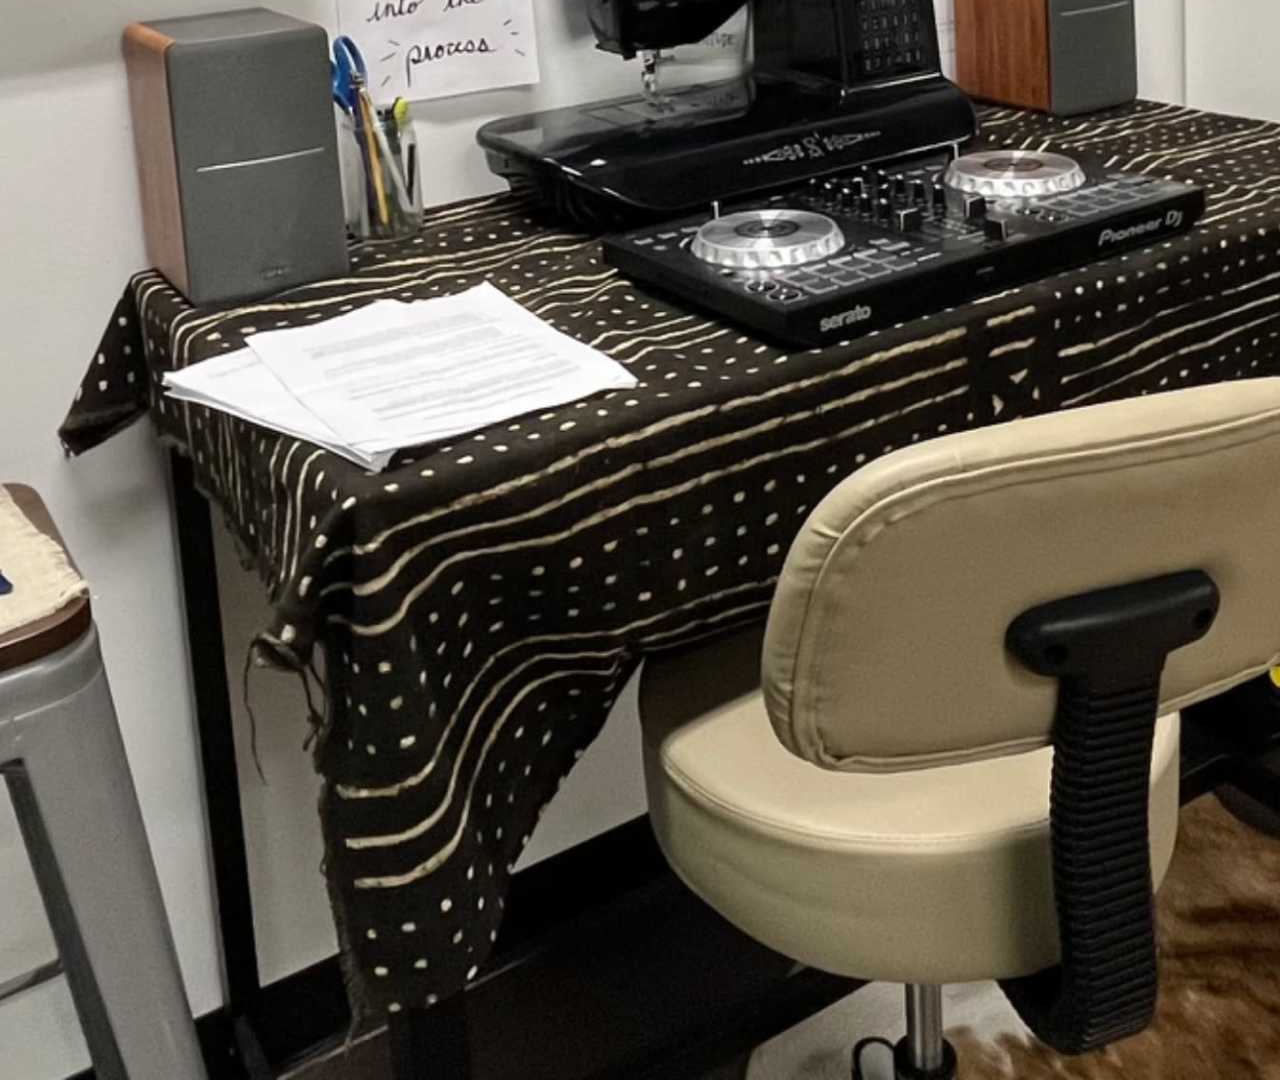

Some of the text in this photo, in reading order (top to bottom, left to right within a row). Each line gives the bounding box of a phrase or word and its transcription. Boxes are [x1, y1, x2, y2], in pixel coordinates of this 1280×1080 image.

[406, 37, 497, 88] process
[1097, 217, 1163, 247] Pioneer
[819, 304, 872, 332] serato
